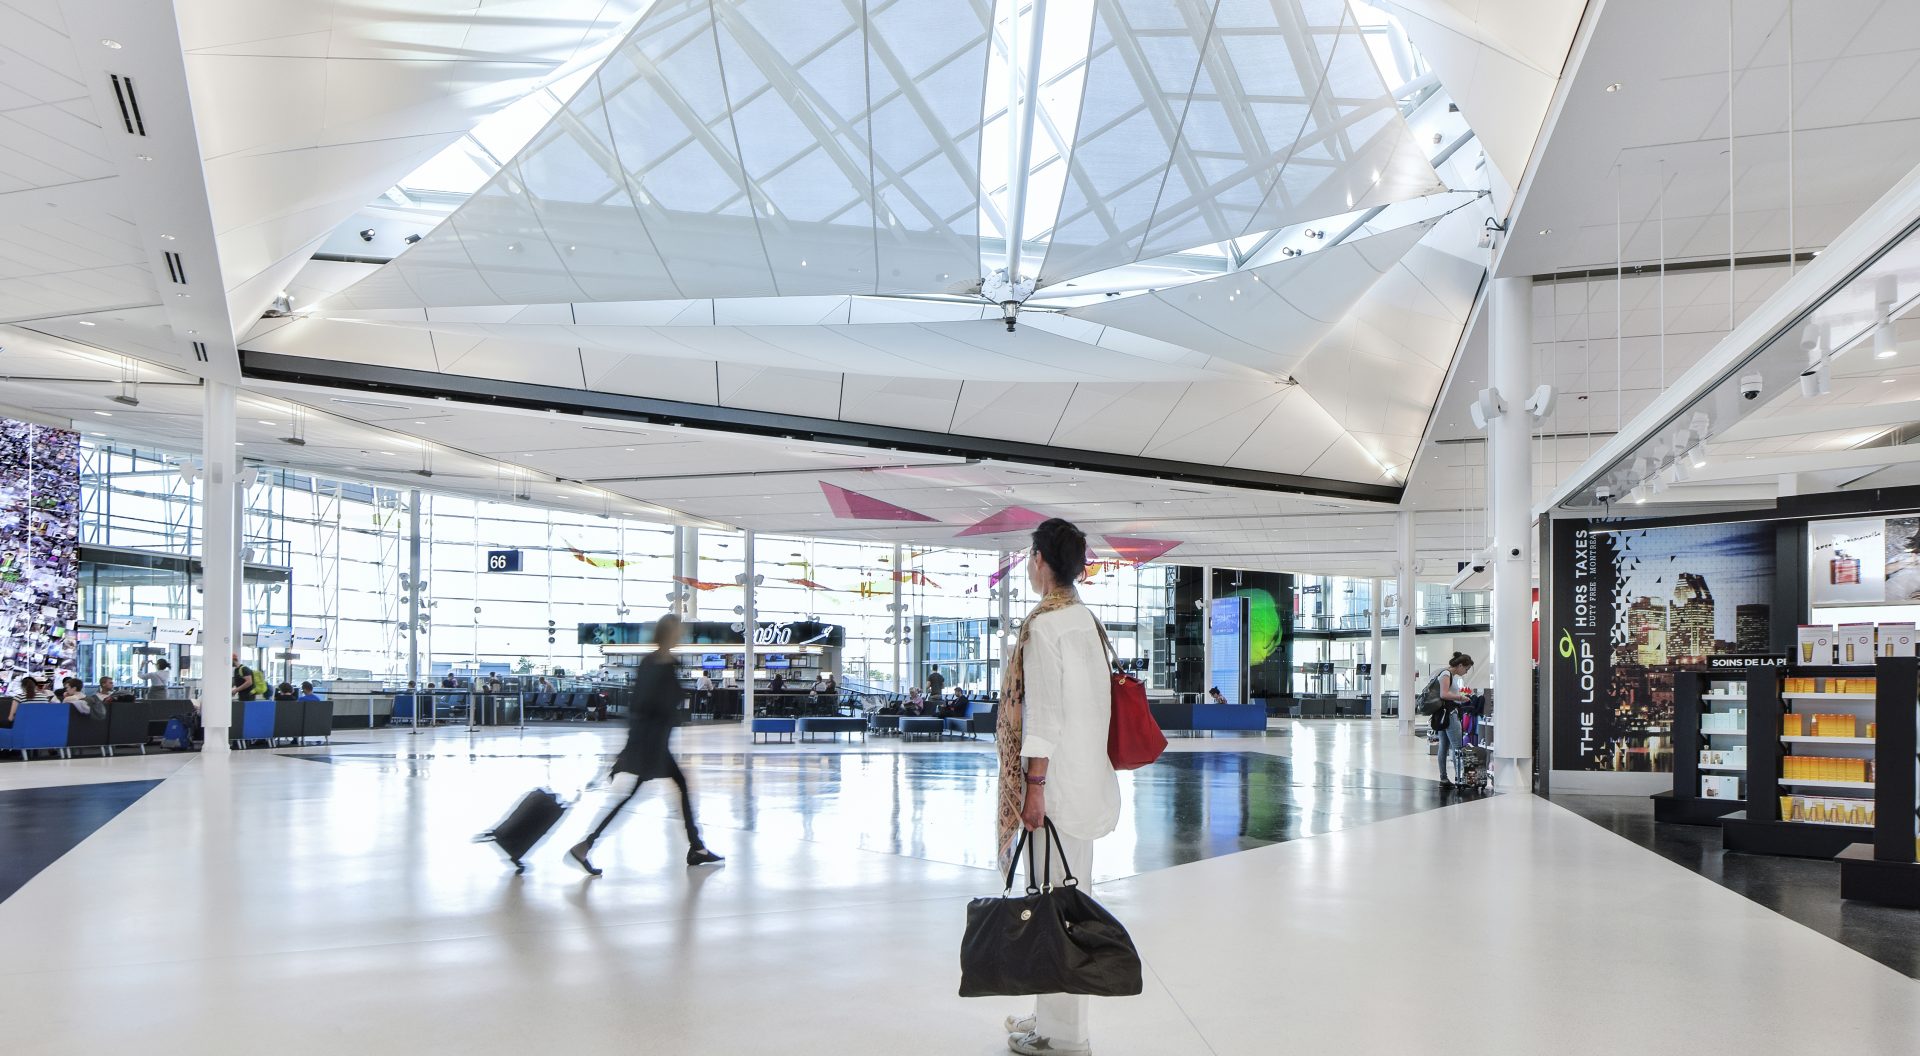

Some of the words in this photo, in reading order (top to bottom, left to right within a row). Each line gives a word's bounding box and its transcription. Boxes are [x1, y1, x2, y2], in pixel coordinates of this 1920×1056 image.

[490, 555, 506, 569] 66
[1575, 530, 1588, 578] TAXES
[1589, 534, 1597, 574] MONTREA
[1575, 584, 1588, 627] HORS
[1589, 582, 1597, 601] FREE
[1589, 604, 1597, 627] DUTY
[1580, 642, 1594, 702] LOOP
[1712, 658, 1743, 667] SOINS
[1744, 658, 1759, 666] DE
[1760, 658, 1775, 666] LA
[1580, 712, 1594, 756] THE
